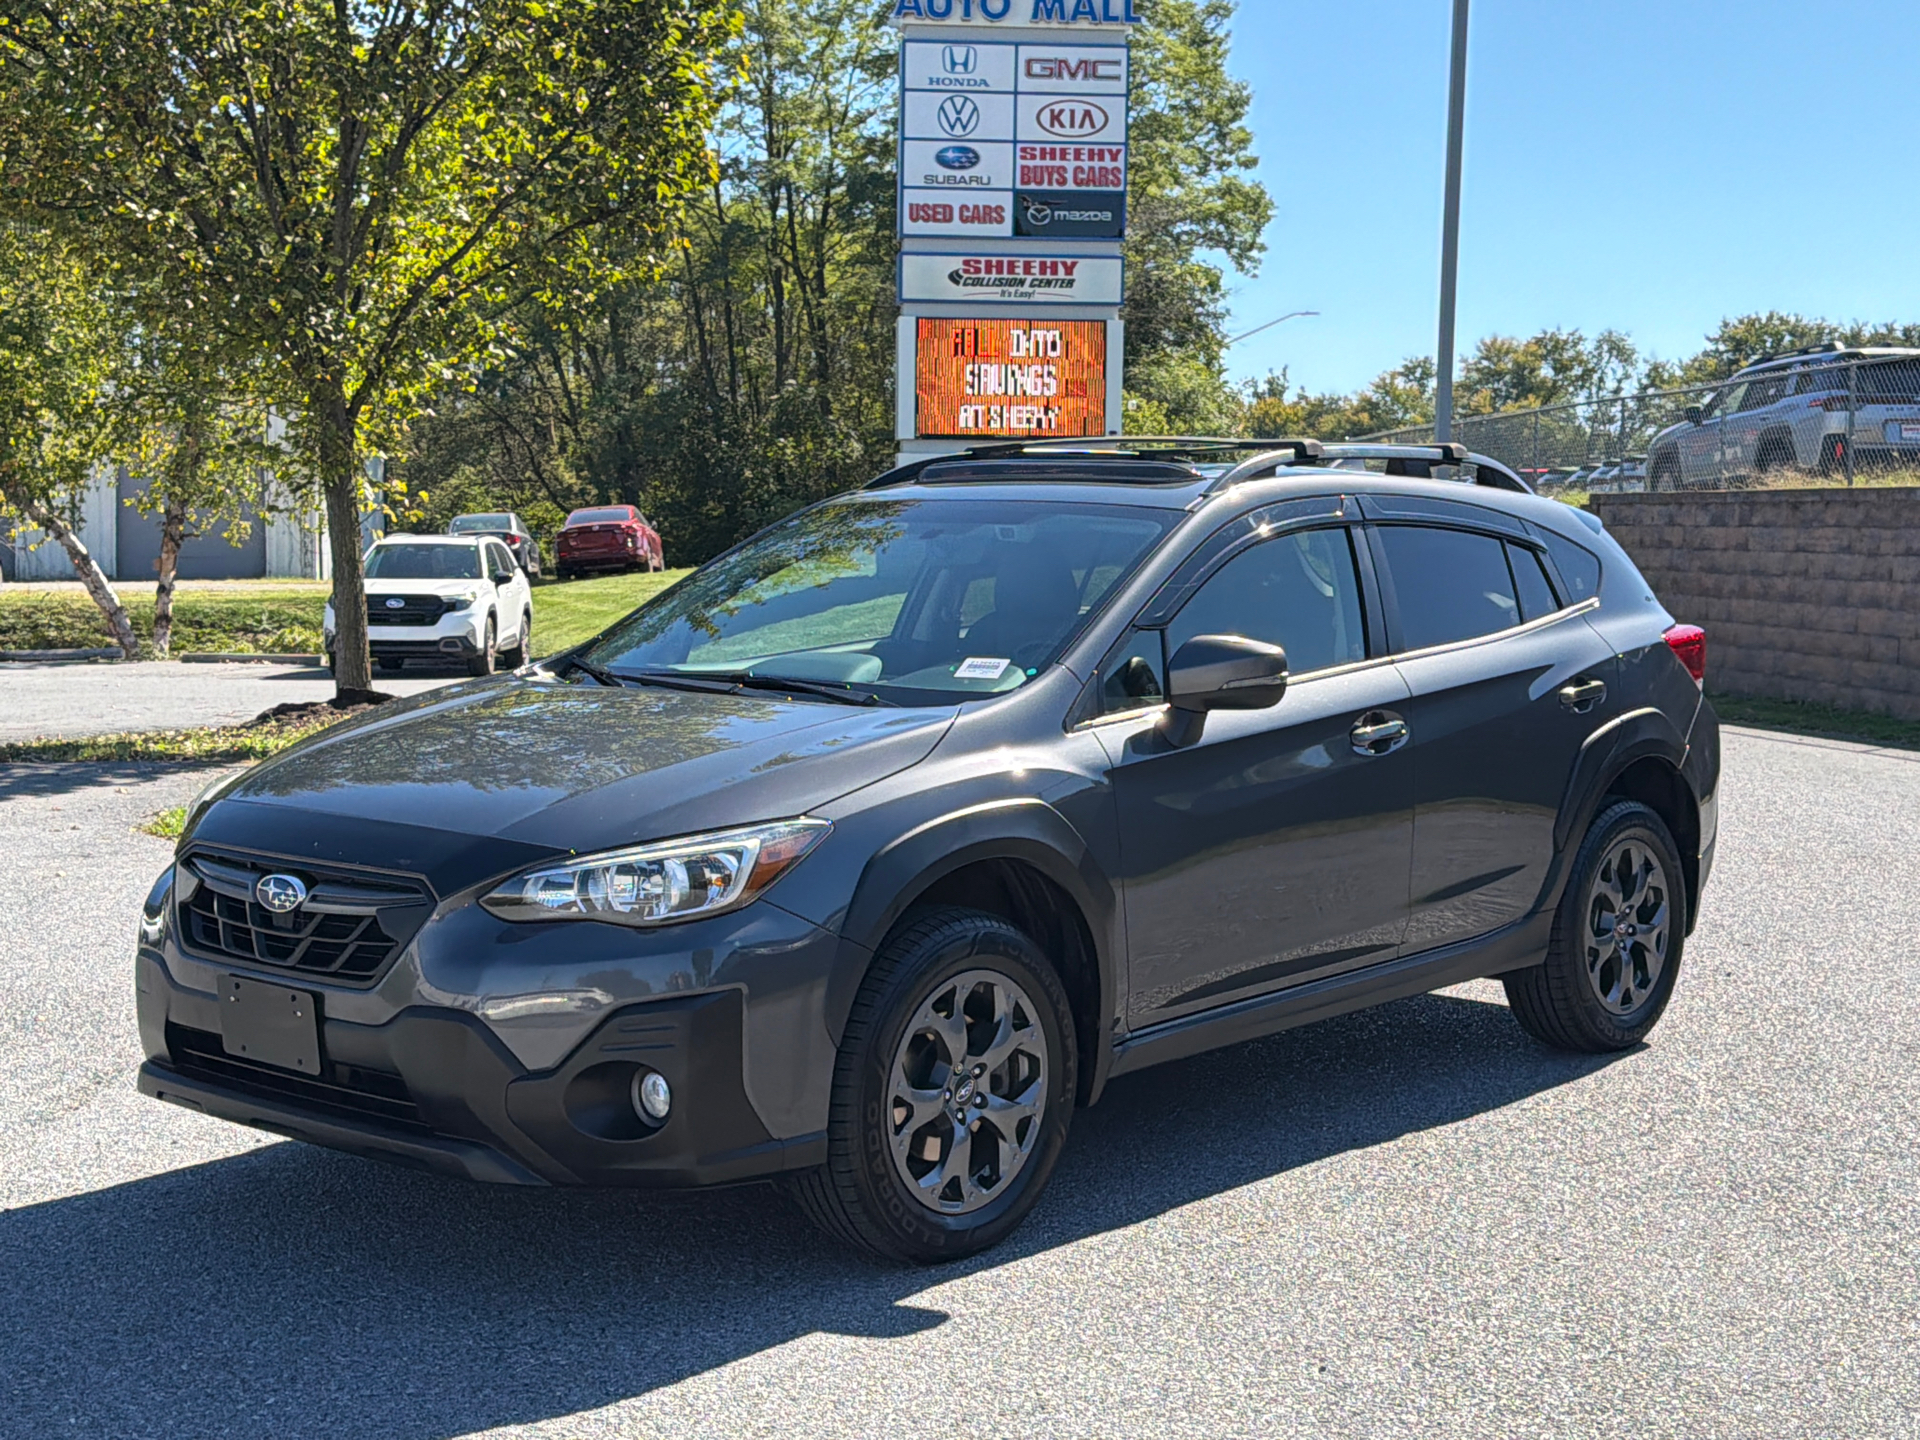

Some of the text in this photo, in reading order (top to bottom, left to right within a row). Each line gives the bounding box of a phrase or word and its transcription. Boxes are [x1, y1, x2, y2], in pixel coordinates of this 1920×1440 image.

[1025, 58, 1122, 81] GMC
[928, 77, 990, 88] HONDA
[1049, 108, 1097, 129] KIA
[1019, 147, 1123, 162] SHEEHY
[923, 174, 991, 186] SUBARU
[1020, 165, 1122, 188] BUYS CARS
[909, 202, 1006, 225] USED CARS
[1054, 211, 1112, 221] mazda
[962, 259, 1080, 276] SHEEHY
[962, 276, 1076, 289] COLLISION CENTER
[1000, 289, 1036, 299] It's Easy!
[952, 328, 999, 357] FALL
[965, 364, 1057, 396] SAVINGS
[959, 405, 983, 428] AT
